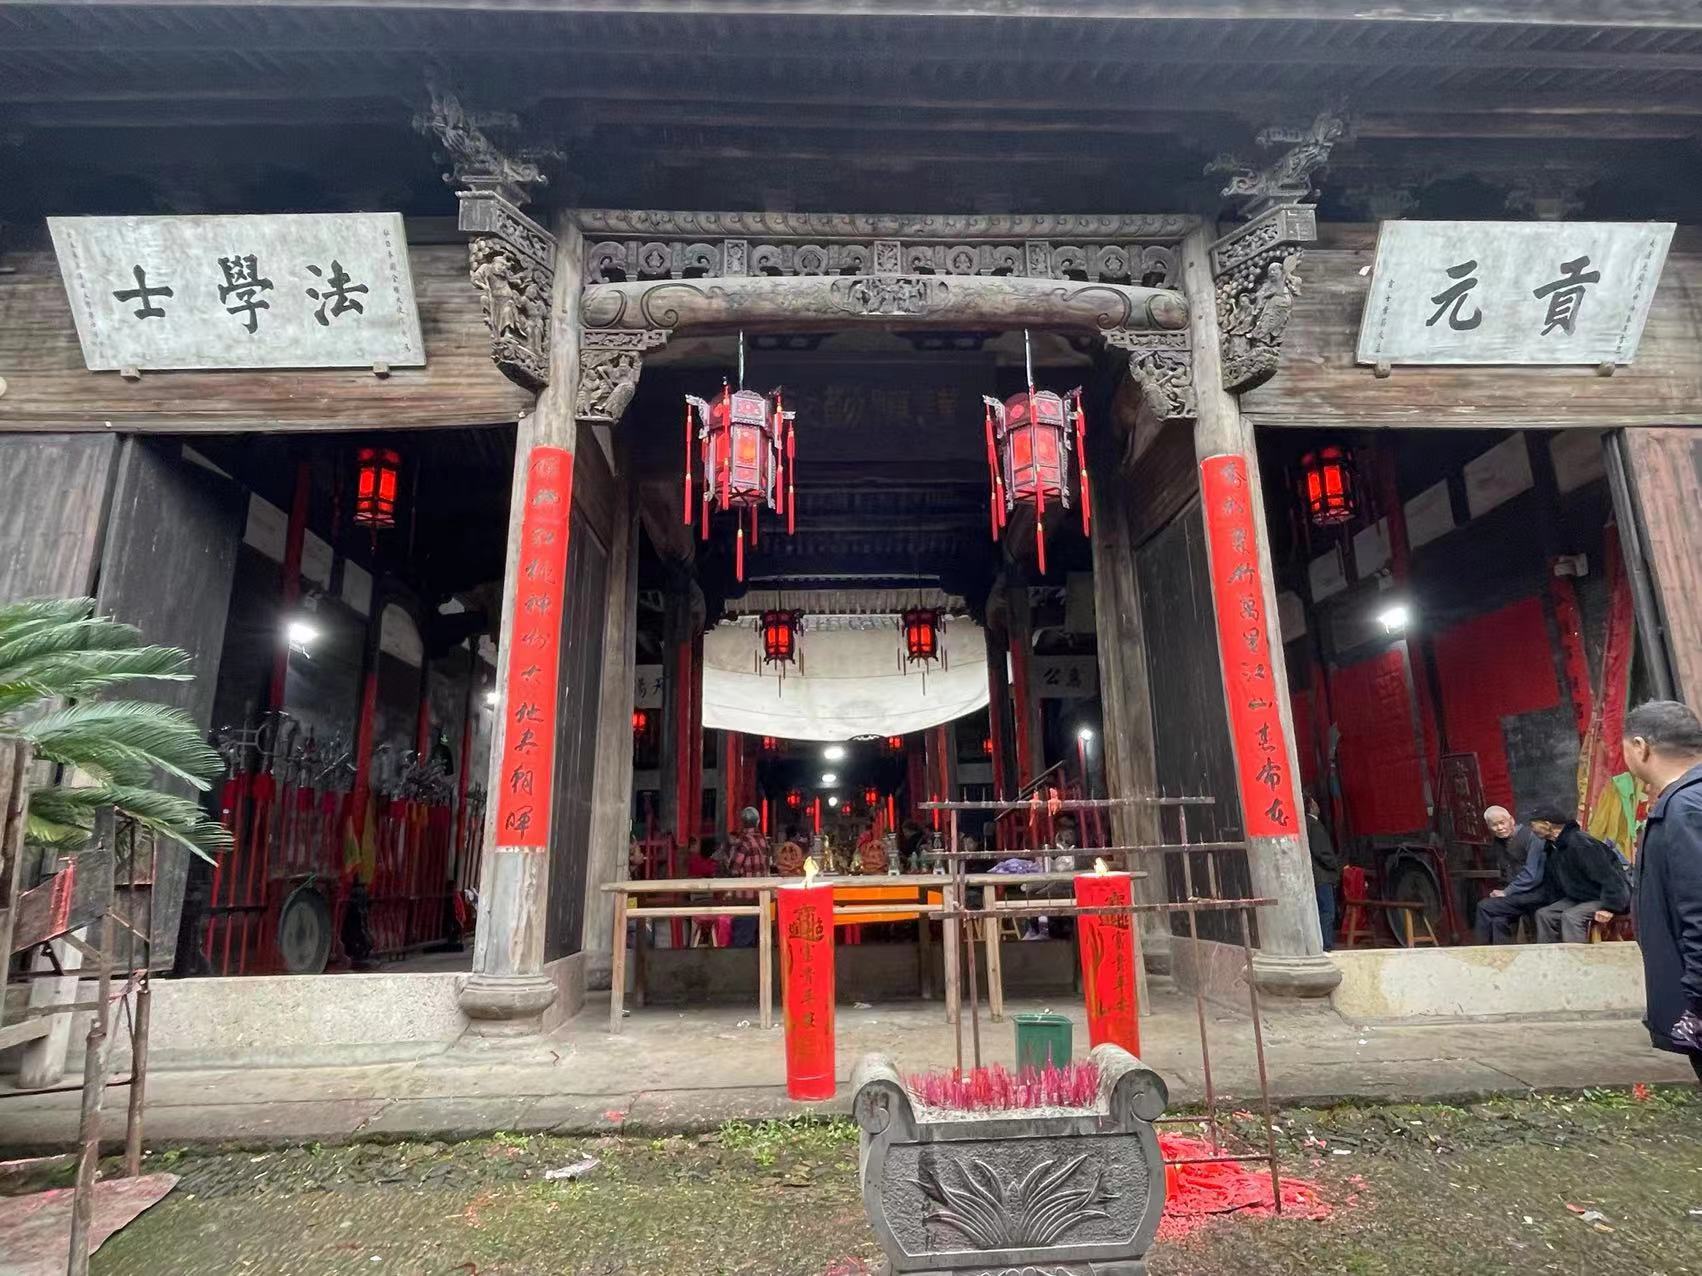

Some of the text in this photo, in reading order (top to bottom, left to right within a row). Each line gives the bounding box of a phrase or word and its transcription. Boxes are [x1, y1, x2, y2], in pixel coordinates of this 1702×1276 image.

[113, 253, 369, 335] 法學士
[1425, 255, 1601, 337] 貢元
